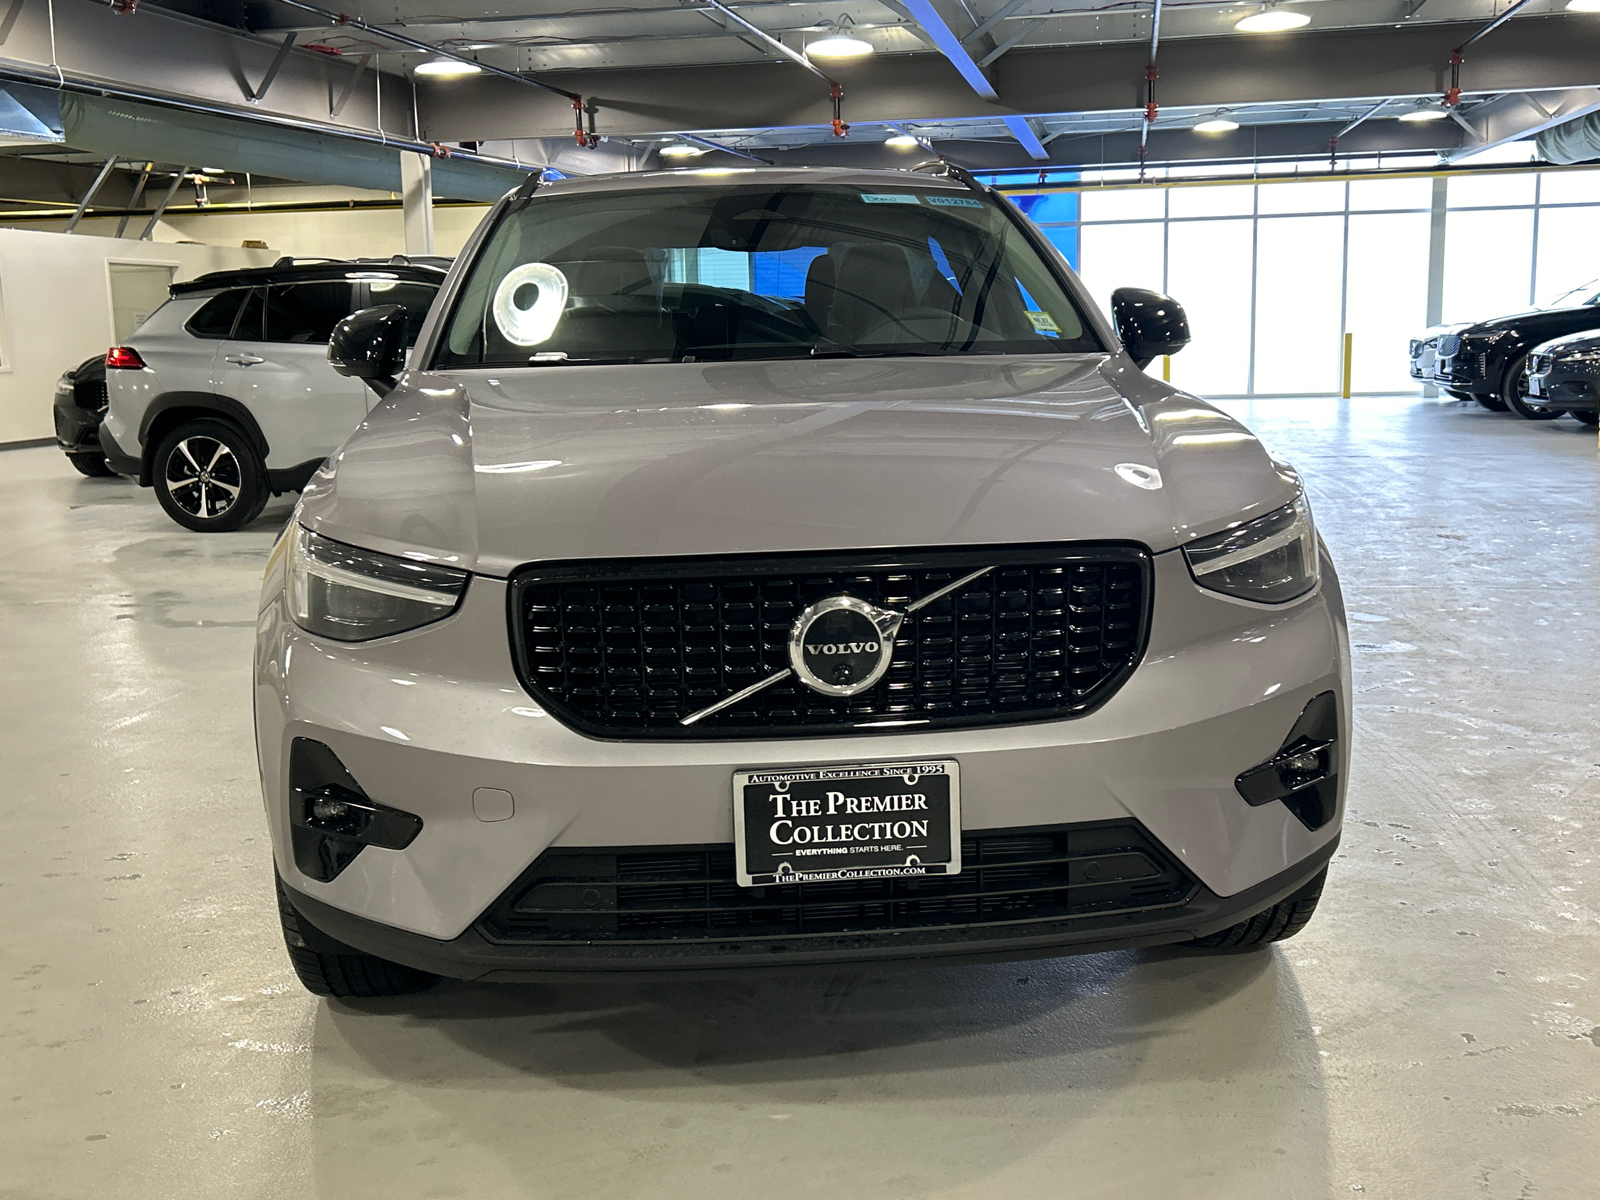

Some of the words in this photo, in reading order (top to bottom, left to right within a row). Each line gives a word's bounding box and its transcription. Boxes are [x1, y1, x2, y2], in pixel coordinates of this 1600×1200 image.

[927, 197, 981, 206] V012784
[805, 641, 879, 655] VOLVO
[916, 765, 944, 775] 1995
[769, 819, 929, 846] COLLECTION
[795, 847, 848, 857] EVERYTHING
[849, 845, 879, 854] STARTS
